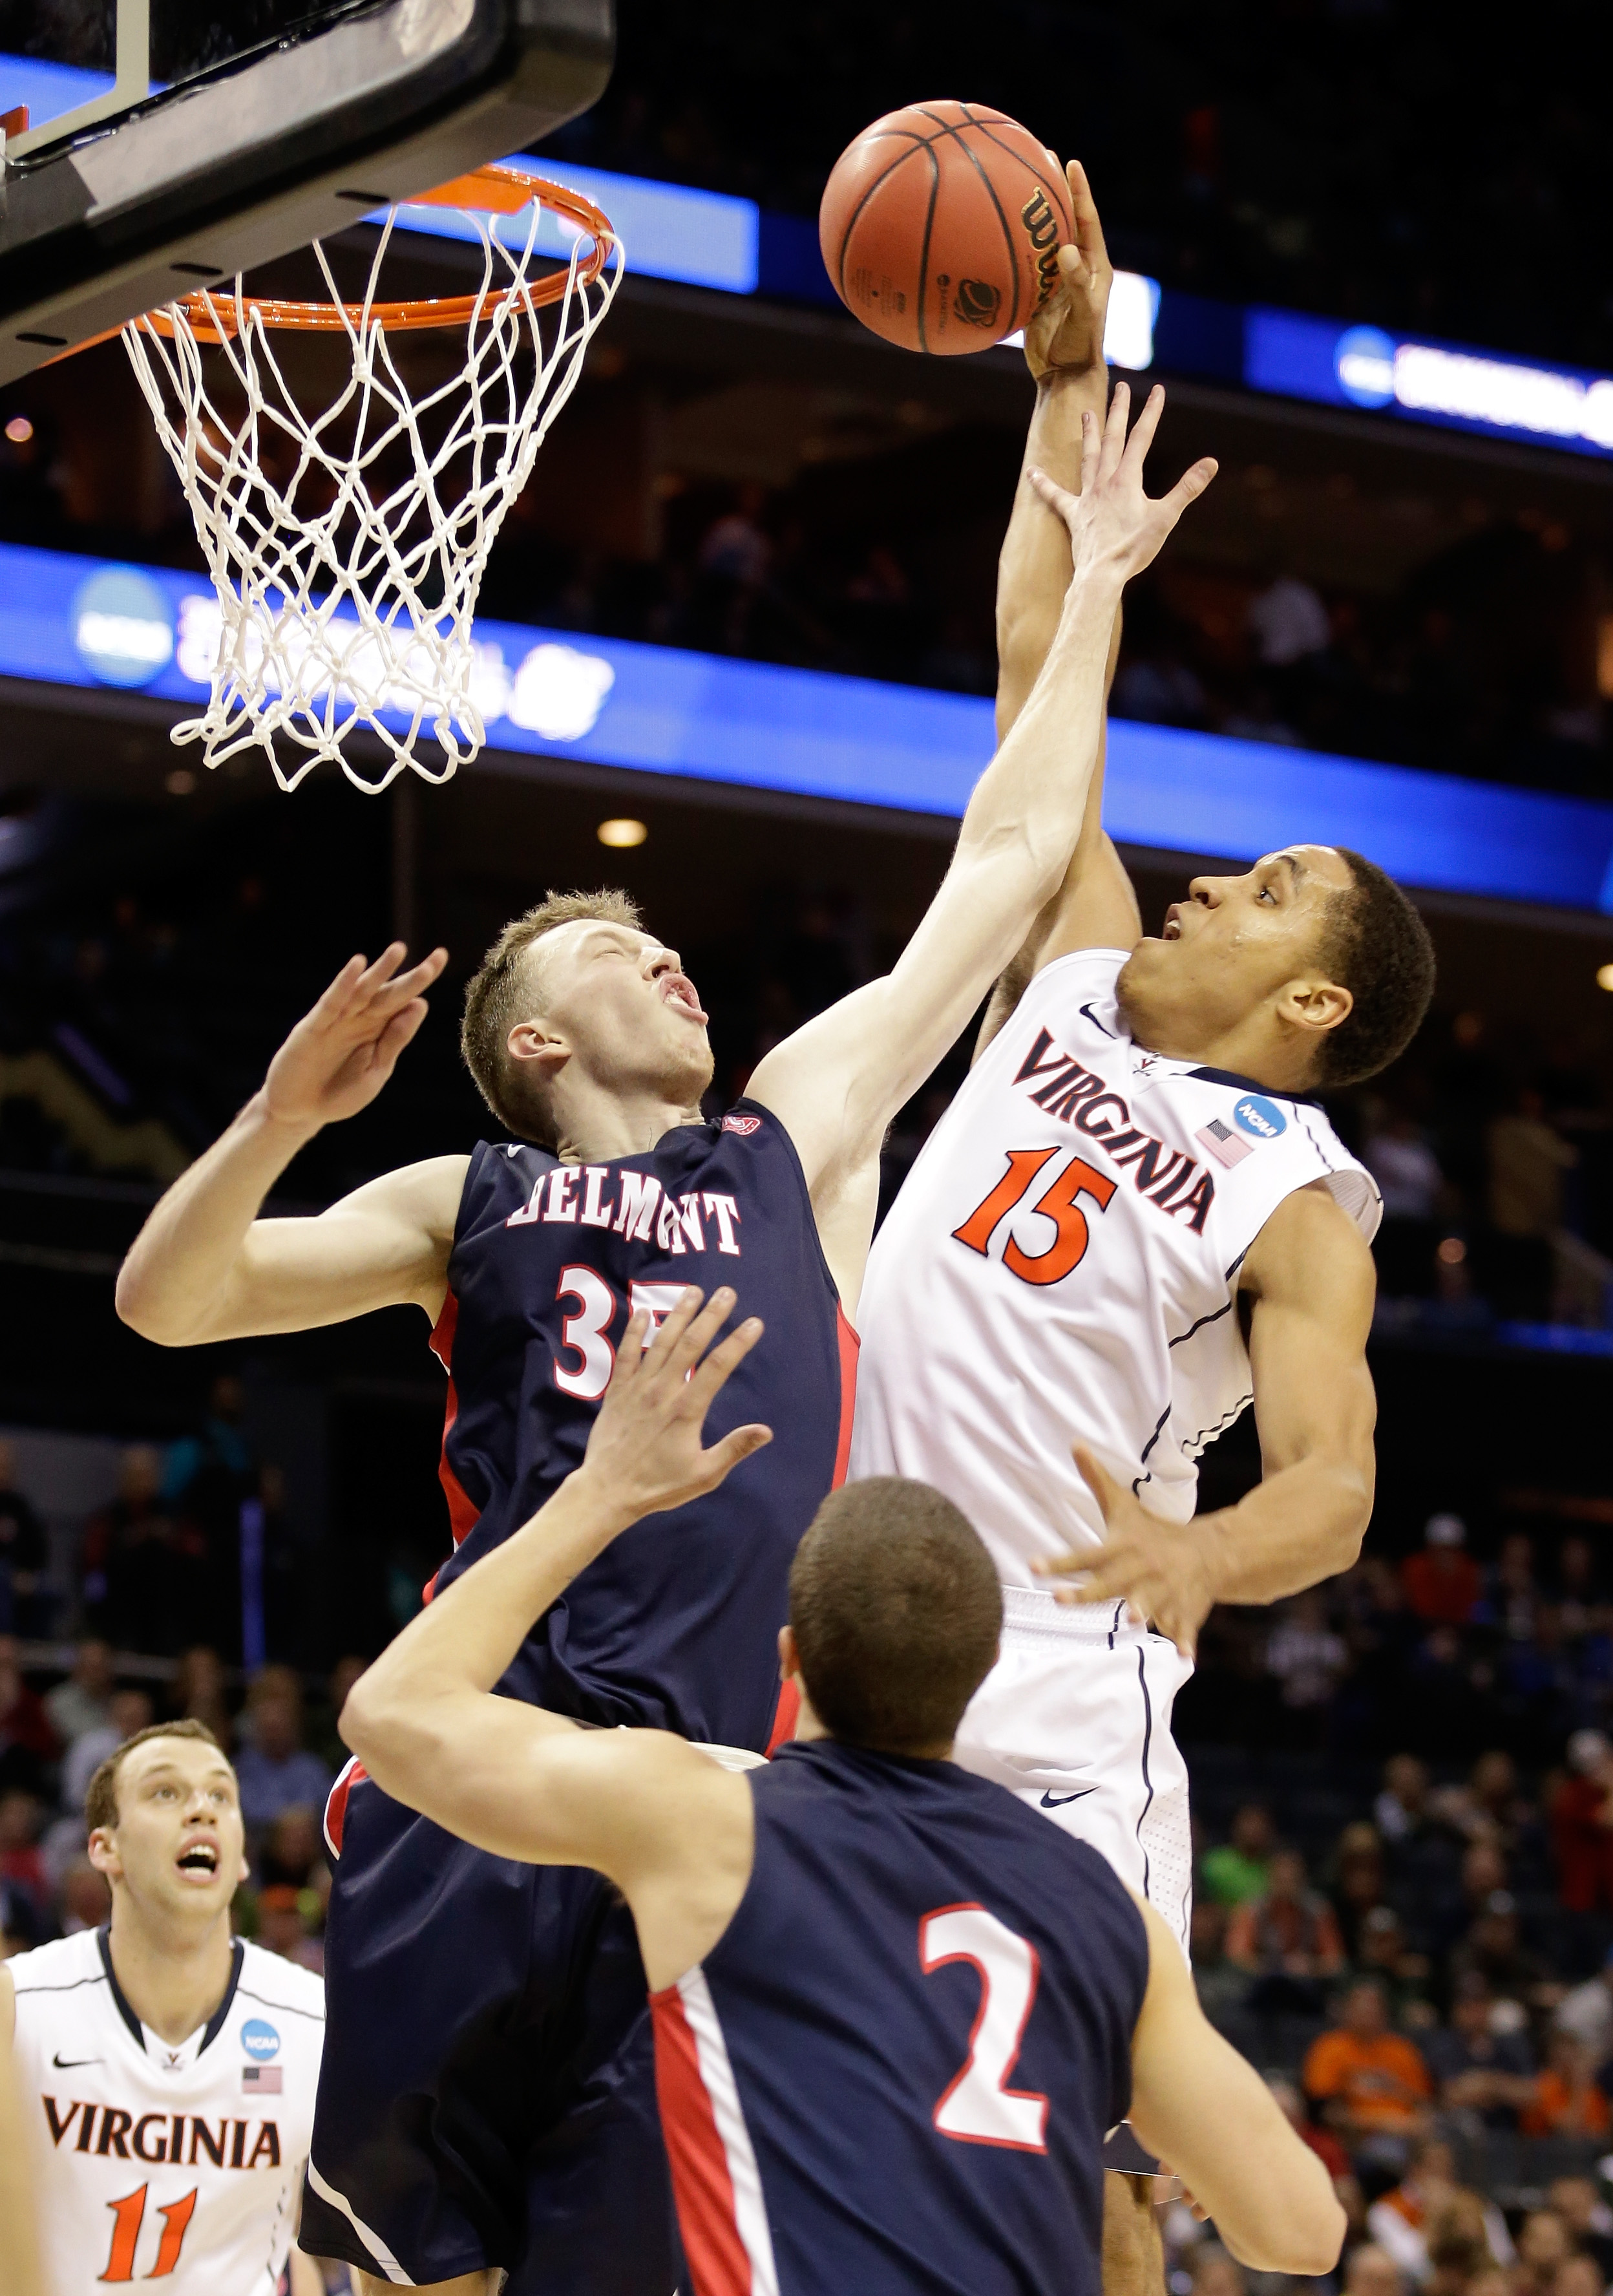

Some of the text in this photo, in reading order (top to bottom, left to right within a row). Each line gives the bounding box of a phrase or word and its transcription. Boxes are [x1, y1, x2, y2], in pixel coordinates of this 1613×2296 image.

[1011, 1025, 1216, 1237] VIRGINIA
[1238, 1103, 1278, 1138] NCAA
[951, 1145, 1118, 1286] 15
[918, 1901, 1049, 2155] 2
[41, 2094, 282, 2169] VIRGINIA
[97, 2182, 198, 2282] 11
